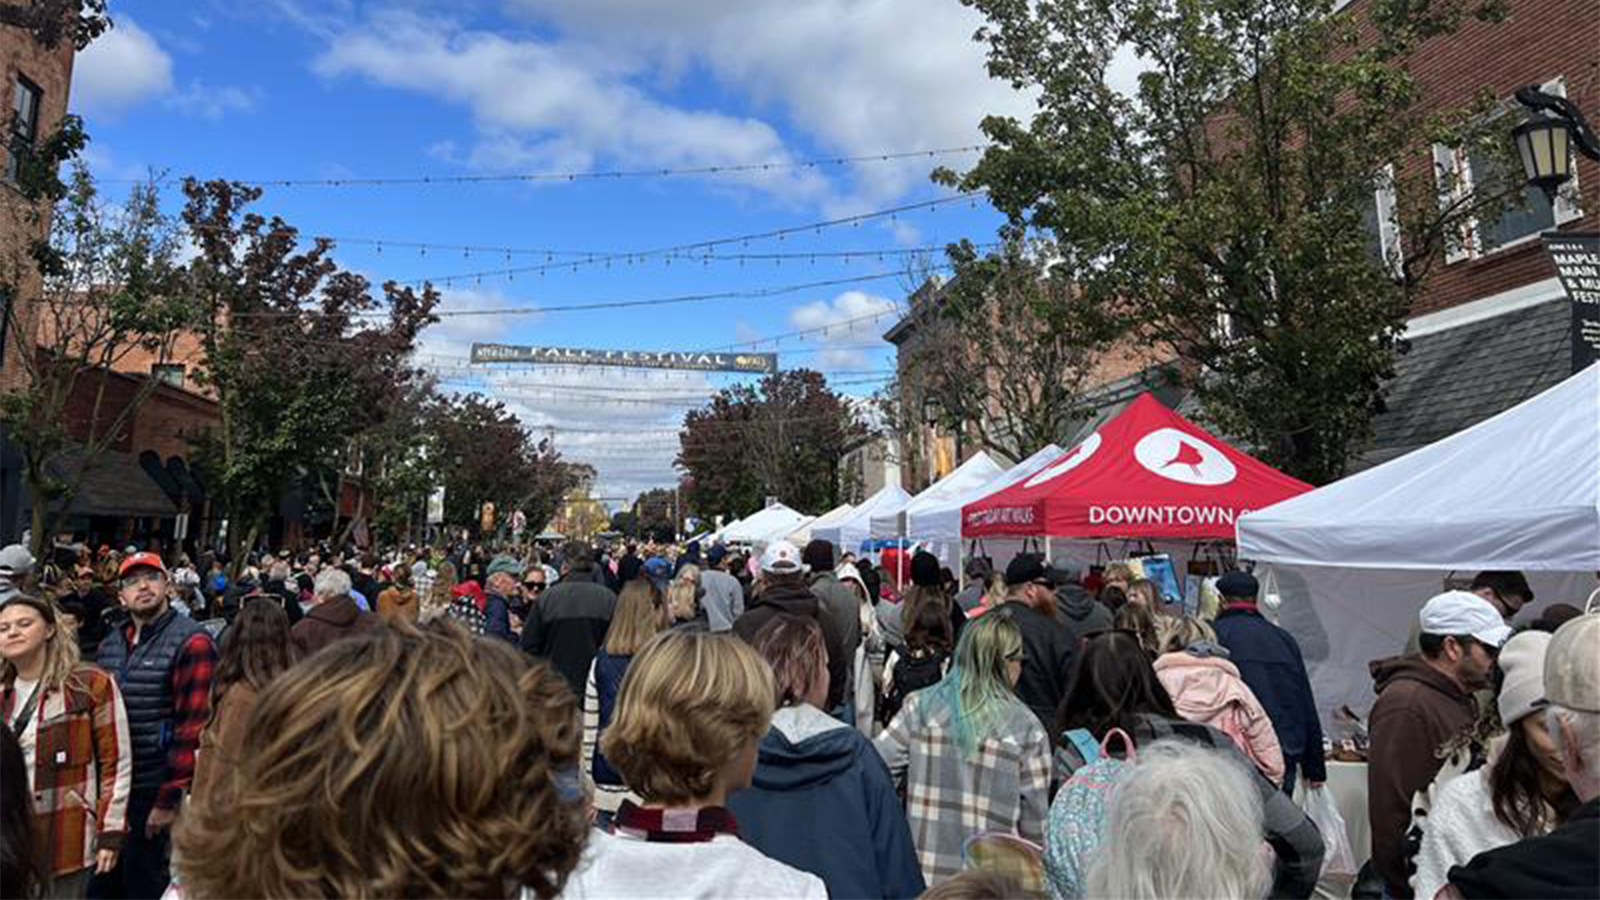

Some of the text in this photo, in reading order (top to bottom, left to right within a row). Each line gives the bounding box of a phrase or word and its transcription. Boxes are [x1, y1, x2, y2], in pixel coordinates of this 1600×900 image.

[1553, 253, 1600, 265] MAPLE
[1559, 266, 1598, 276] MAIN
[1566, 278, 1579, 289] &
[530, 346, 592, 359] FALL
[605, 350, 728, 366] FESTIVAL
[1088, 505, 1234, 525] DOWNTOWN
